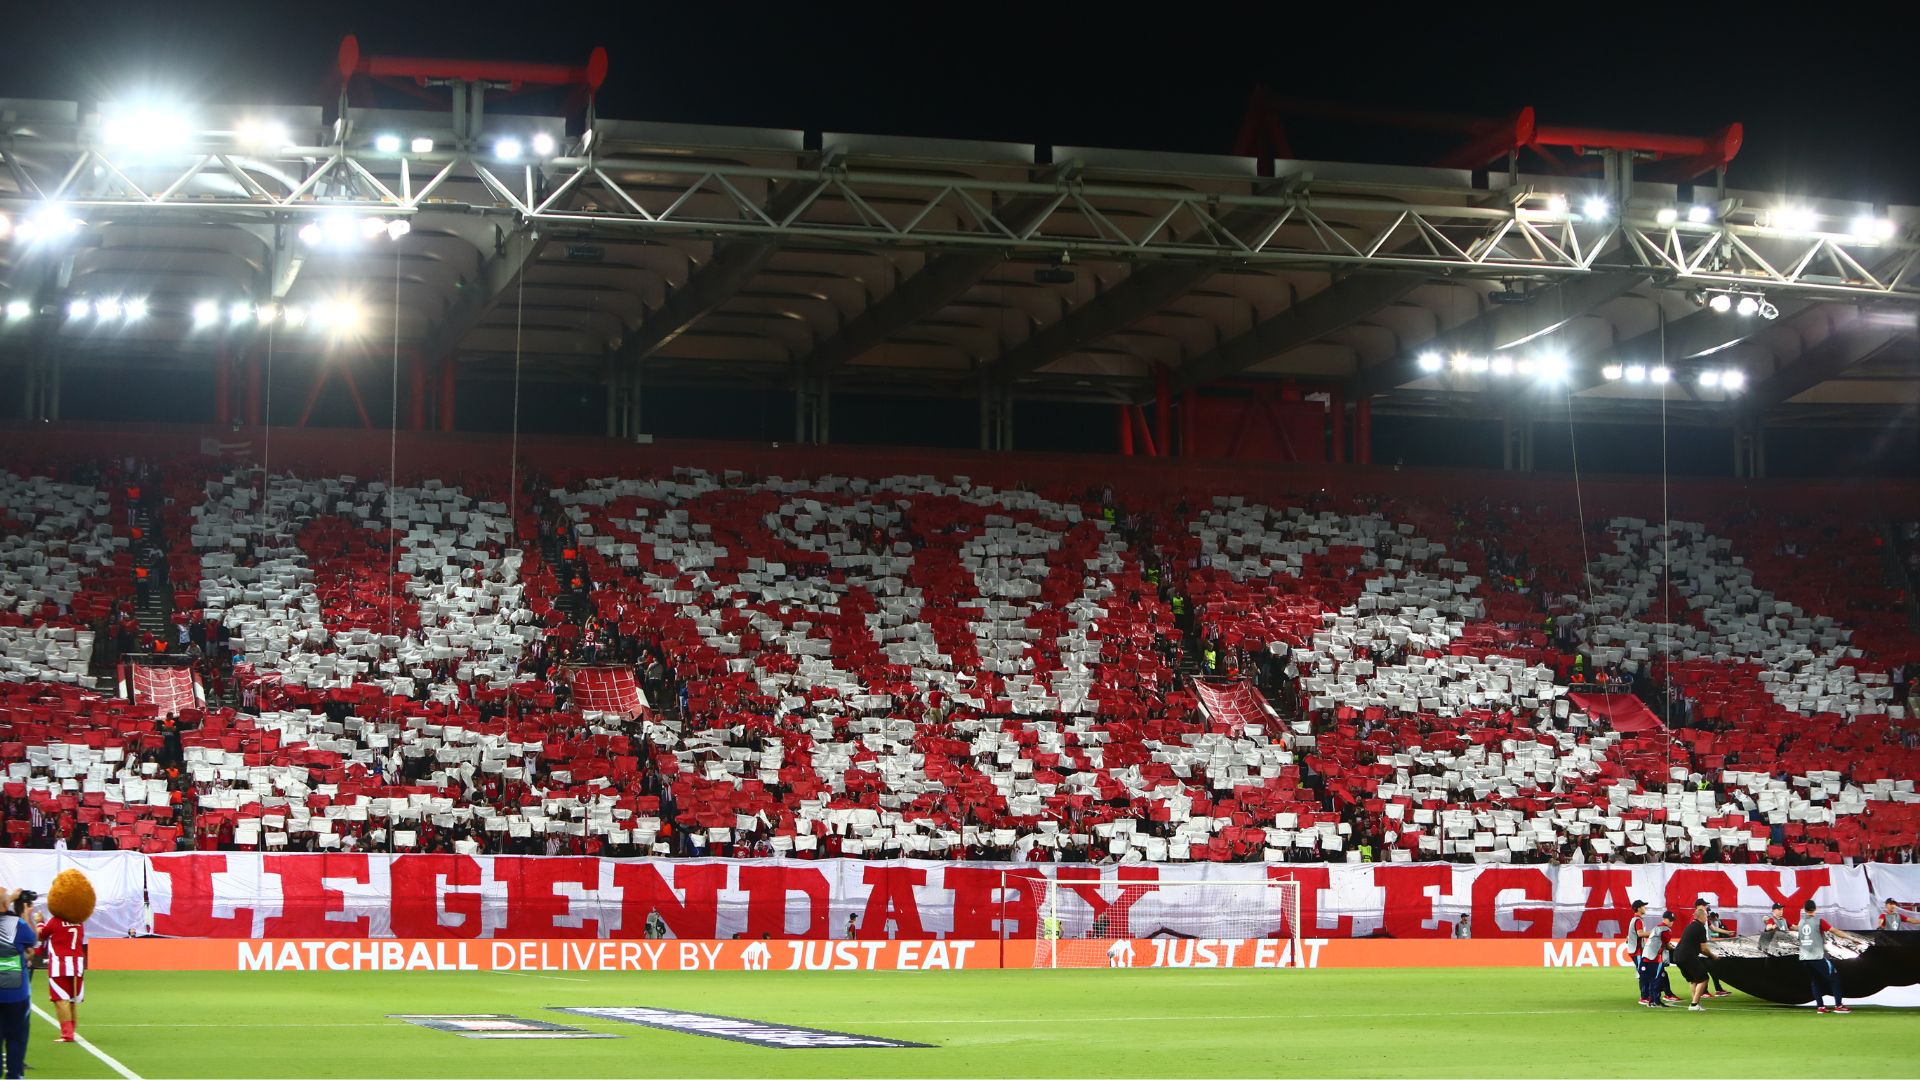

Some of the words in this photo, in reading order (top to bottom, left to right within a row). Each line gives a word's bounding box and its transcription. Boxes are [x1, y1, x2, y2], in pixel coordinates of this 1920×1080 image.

[150, 853, 1160, 939] LEGENDARY
[1267, 863, 1831, 939] LEGACY
[68, 927, 78, 950] 7
[1150, 939, 1246, 968] JUST
[1253, 939, 1329, 968] EAT
[238, 941, 479, 971] MATCHBALL
[491, 941, 667, 970] DELIVERY
[679, 941, 724, 970] BY
[785, 940, 887, 970] JUST
[896, 940, 976, 970] EAT
